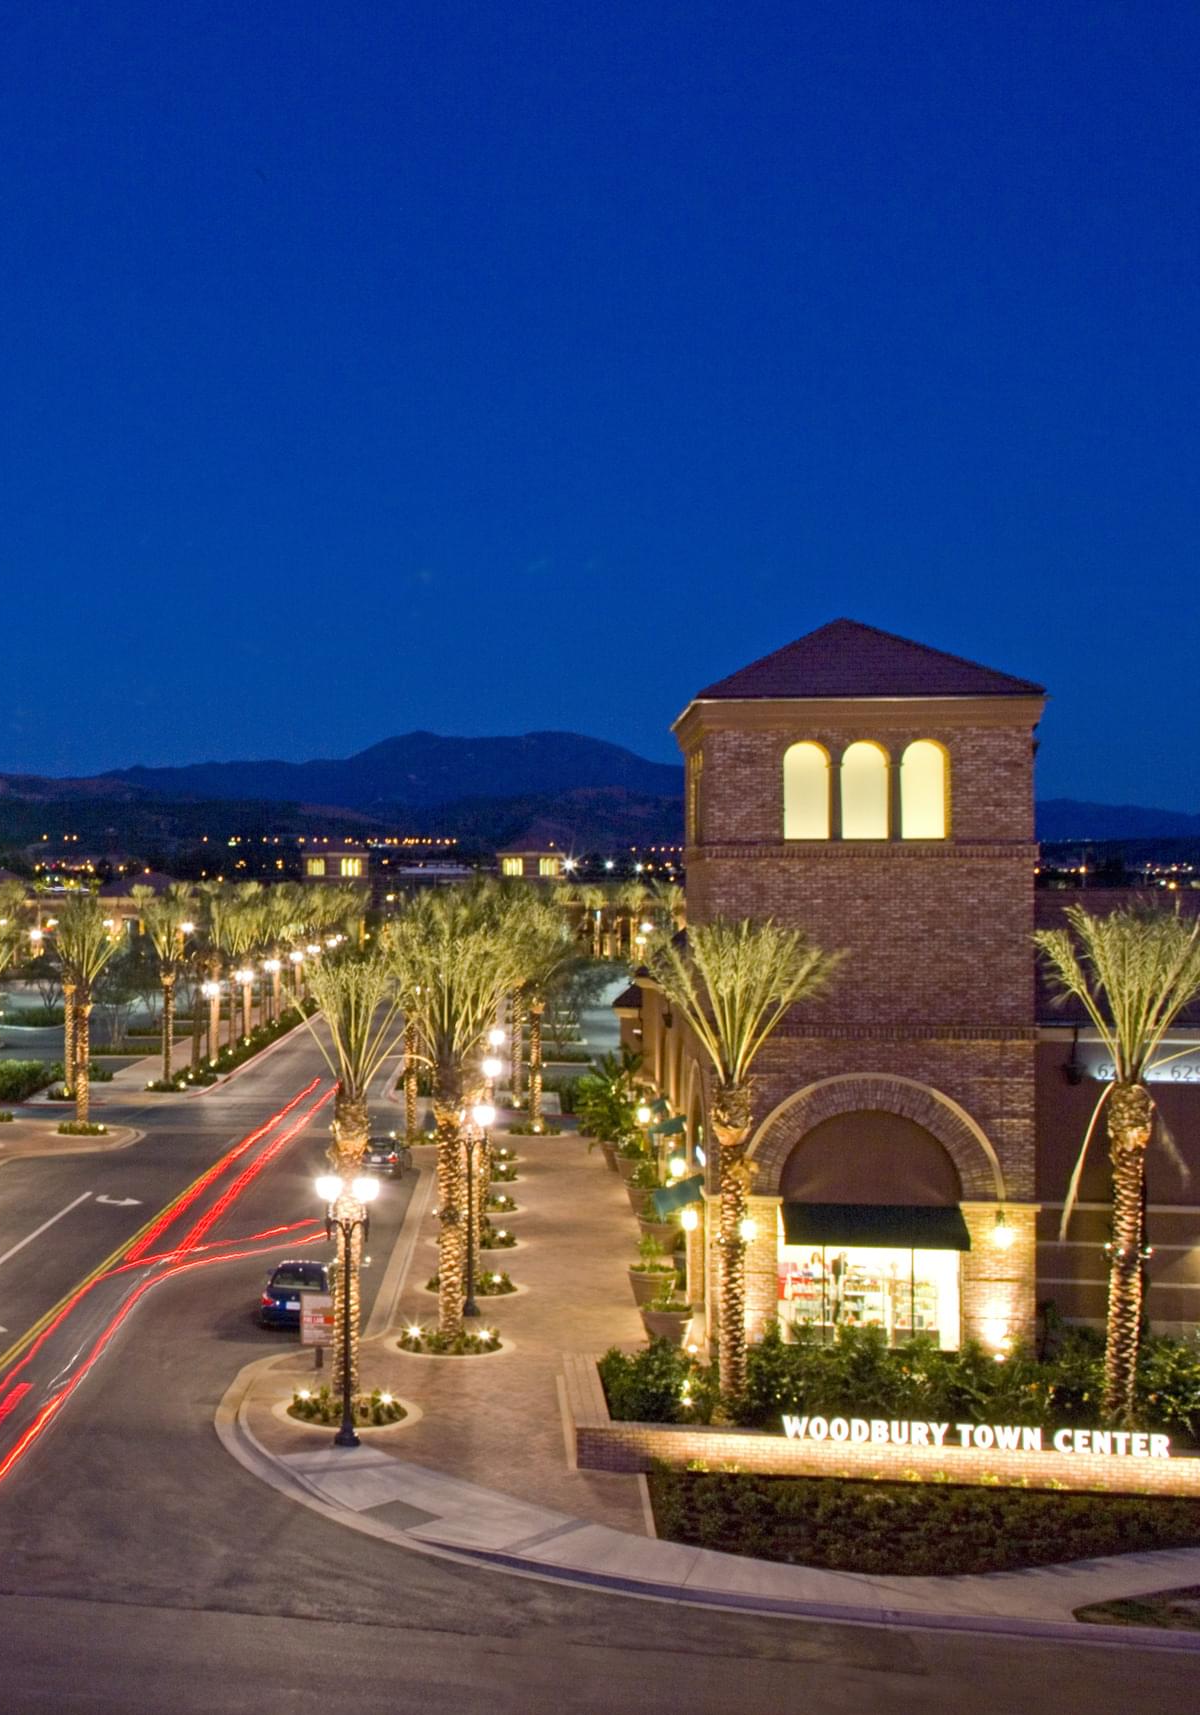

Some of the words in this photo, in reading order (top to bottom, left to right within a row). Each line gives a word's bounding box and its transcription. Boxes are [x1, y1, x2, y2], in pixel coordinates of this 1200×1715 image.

[782, 1415, 950, 1446] WOODBURY
[956, 1424, 1042, 1451] TOWN
[1053, 1428, 1171, 1458] CENTER
